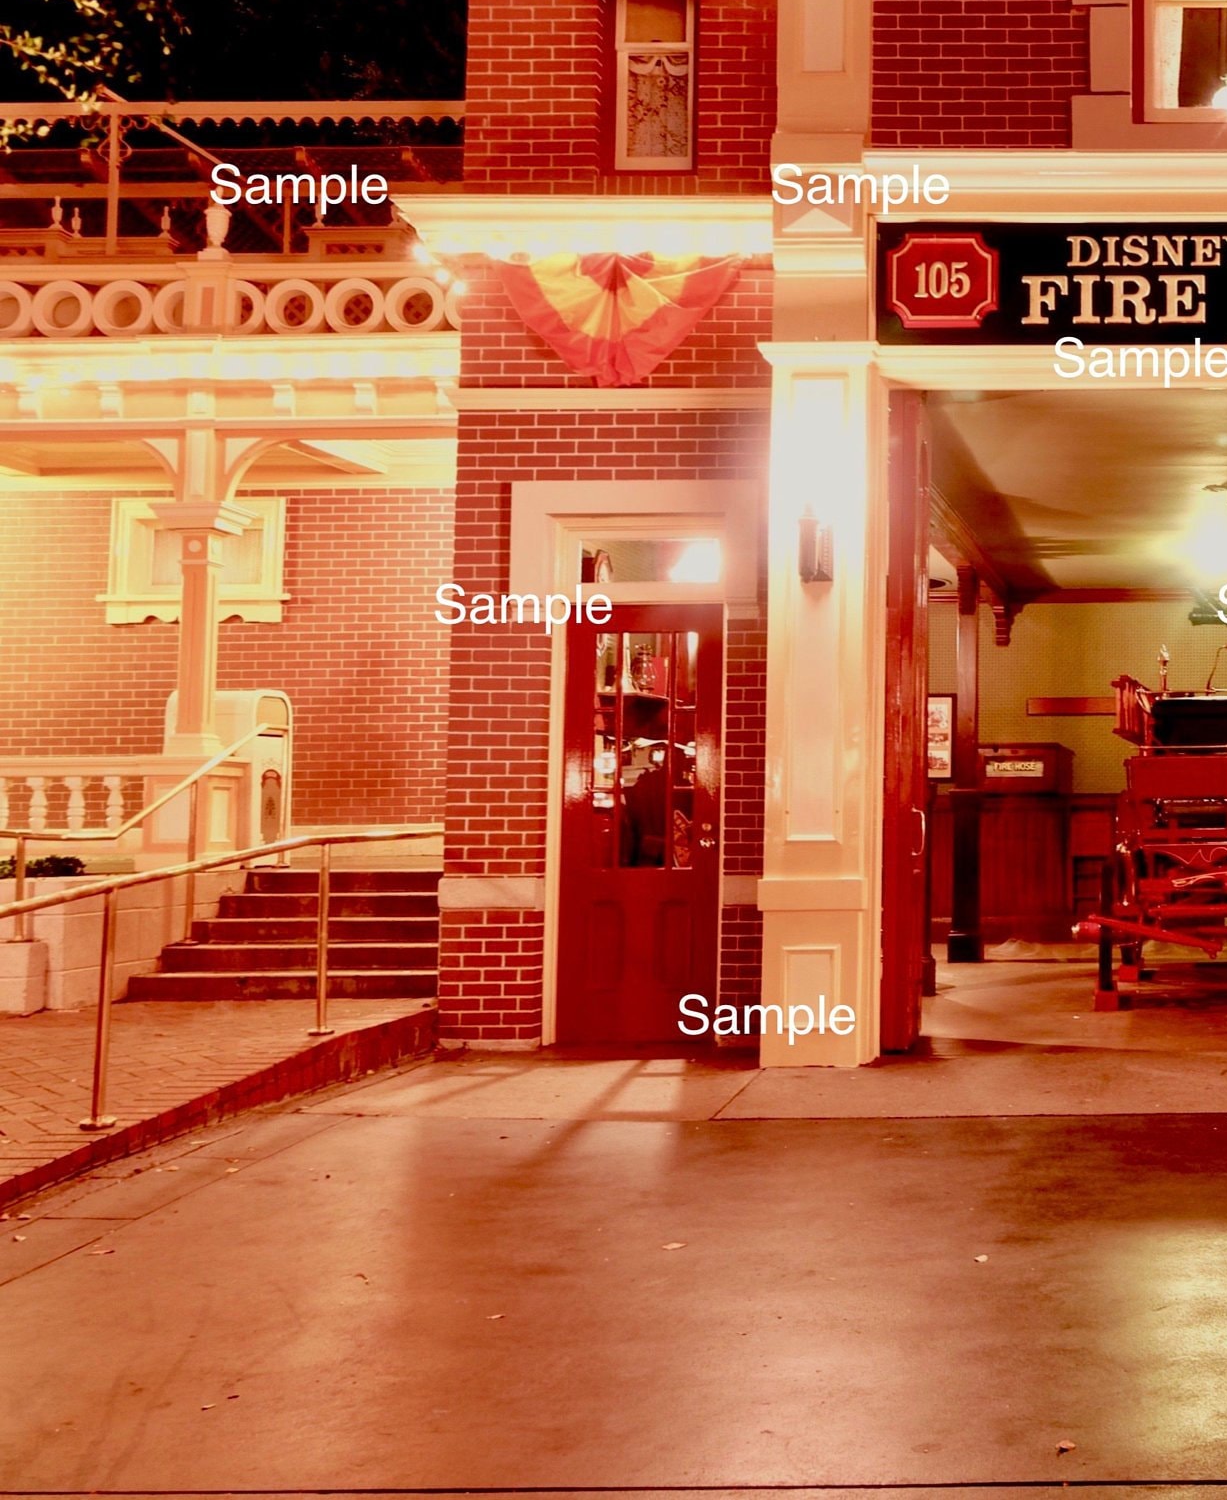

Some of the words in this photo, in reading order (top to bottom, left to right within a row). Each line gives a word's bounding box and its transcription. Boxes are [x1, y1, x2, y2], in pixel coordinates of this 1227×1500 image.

[914, 261, 971, 299] 105
[1021, 274, 1207, 325] FIRE
[994, 762, 1013, 771] FIRE
[1014, 762, 1036, 771] HOSE
